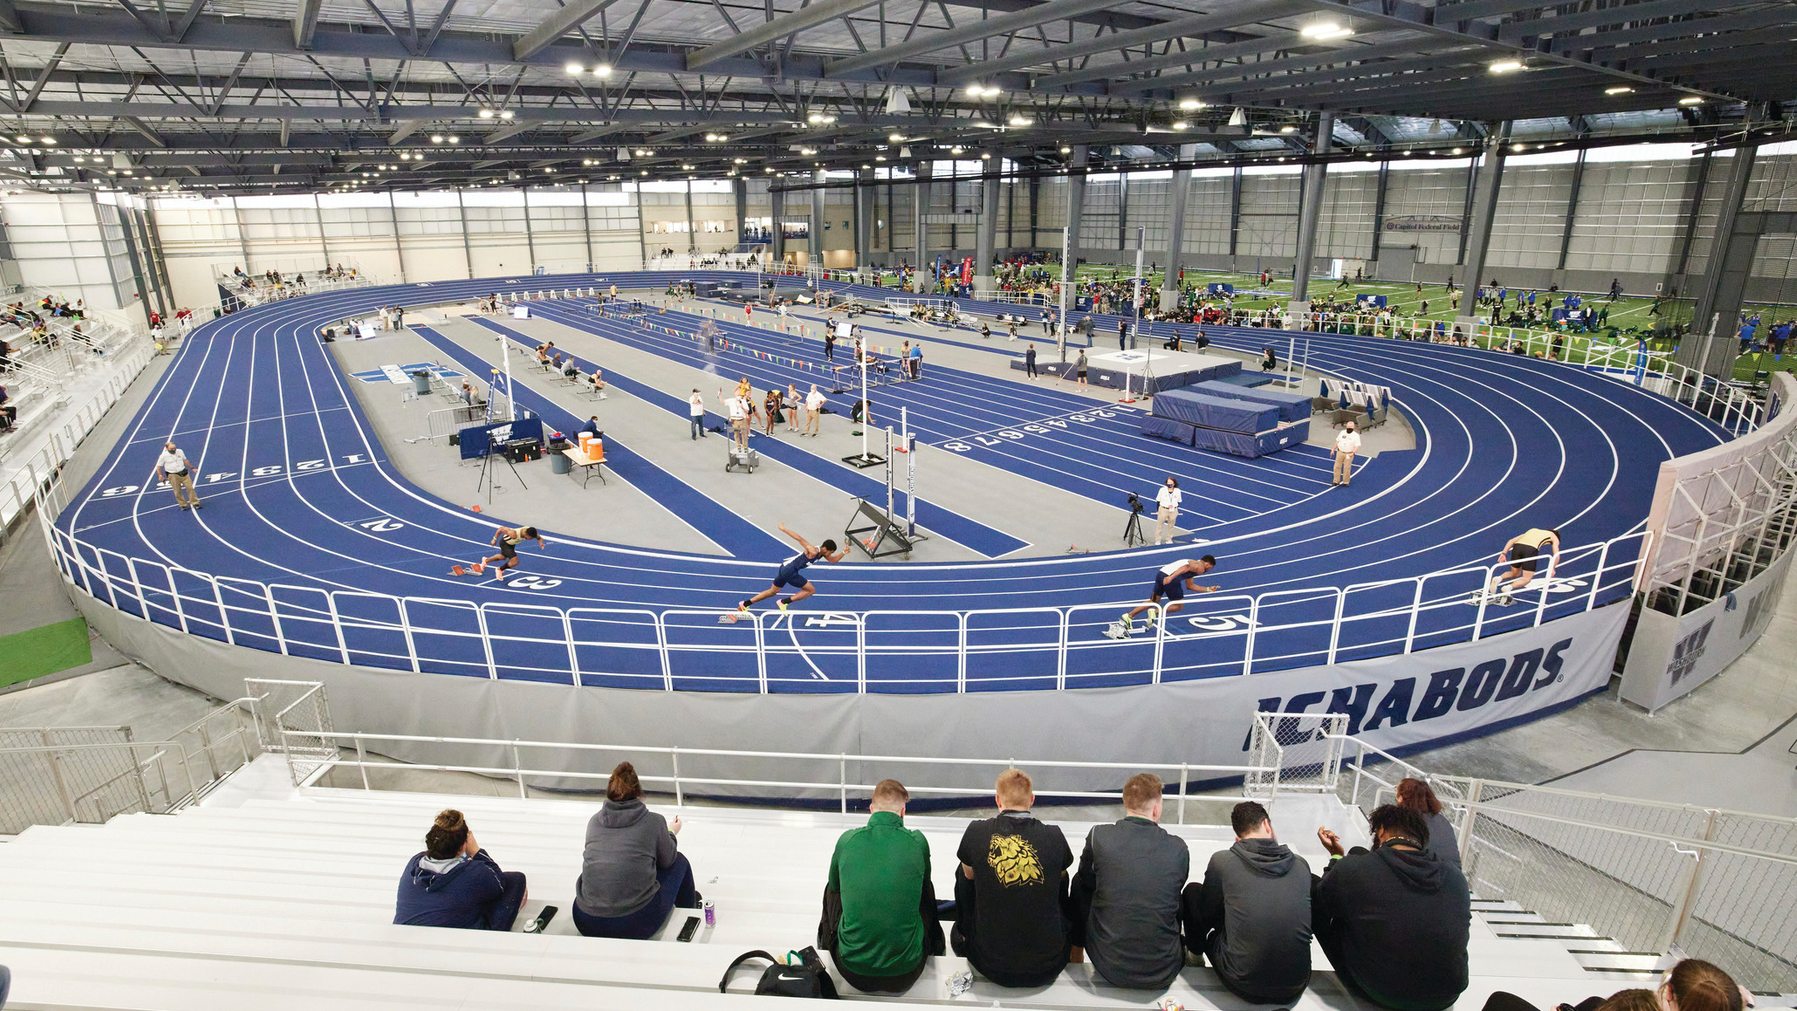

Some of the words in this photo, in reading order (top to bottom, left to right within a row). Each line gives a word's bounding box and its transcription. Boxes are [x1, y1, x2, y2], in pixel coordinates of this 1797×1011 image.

[1089, 409, 1117, 418] 2
[1110, 405, 1137, 413] 1
[1044, 420, 1068, 428] 4
[1069, 414, 1096, 423] 3
[1023, 424, 1051, 434] 5
[998, 430, 1024, 440] 6
[975, 436, 1002, 446] 7
[943, 442, 972, 452] 8
[342, 453, 366, 464] 1
[296, 459, 325, 470] 2
[252, 465, 282, 476] 3
[205, 471, 238, 482] 4
[102, 485, 139, 497] 6
[360, 518, 404, 532] 2
[507, 576, 562, 590] 3
[803, 612, 866, 628] 4
[1188, 612, 1263, 631] 5
[1242, 637, 1573, 751] ICHABODS
